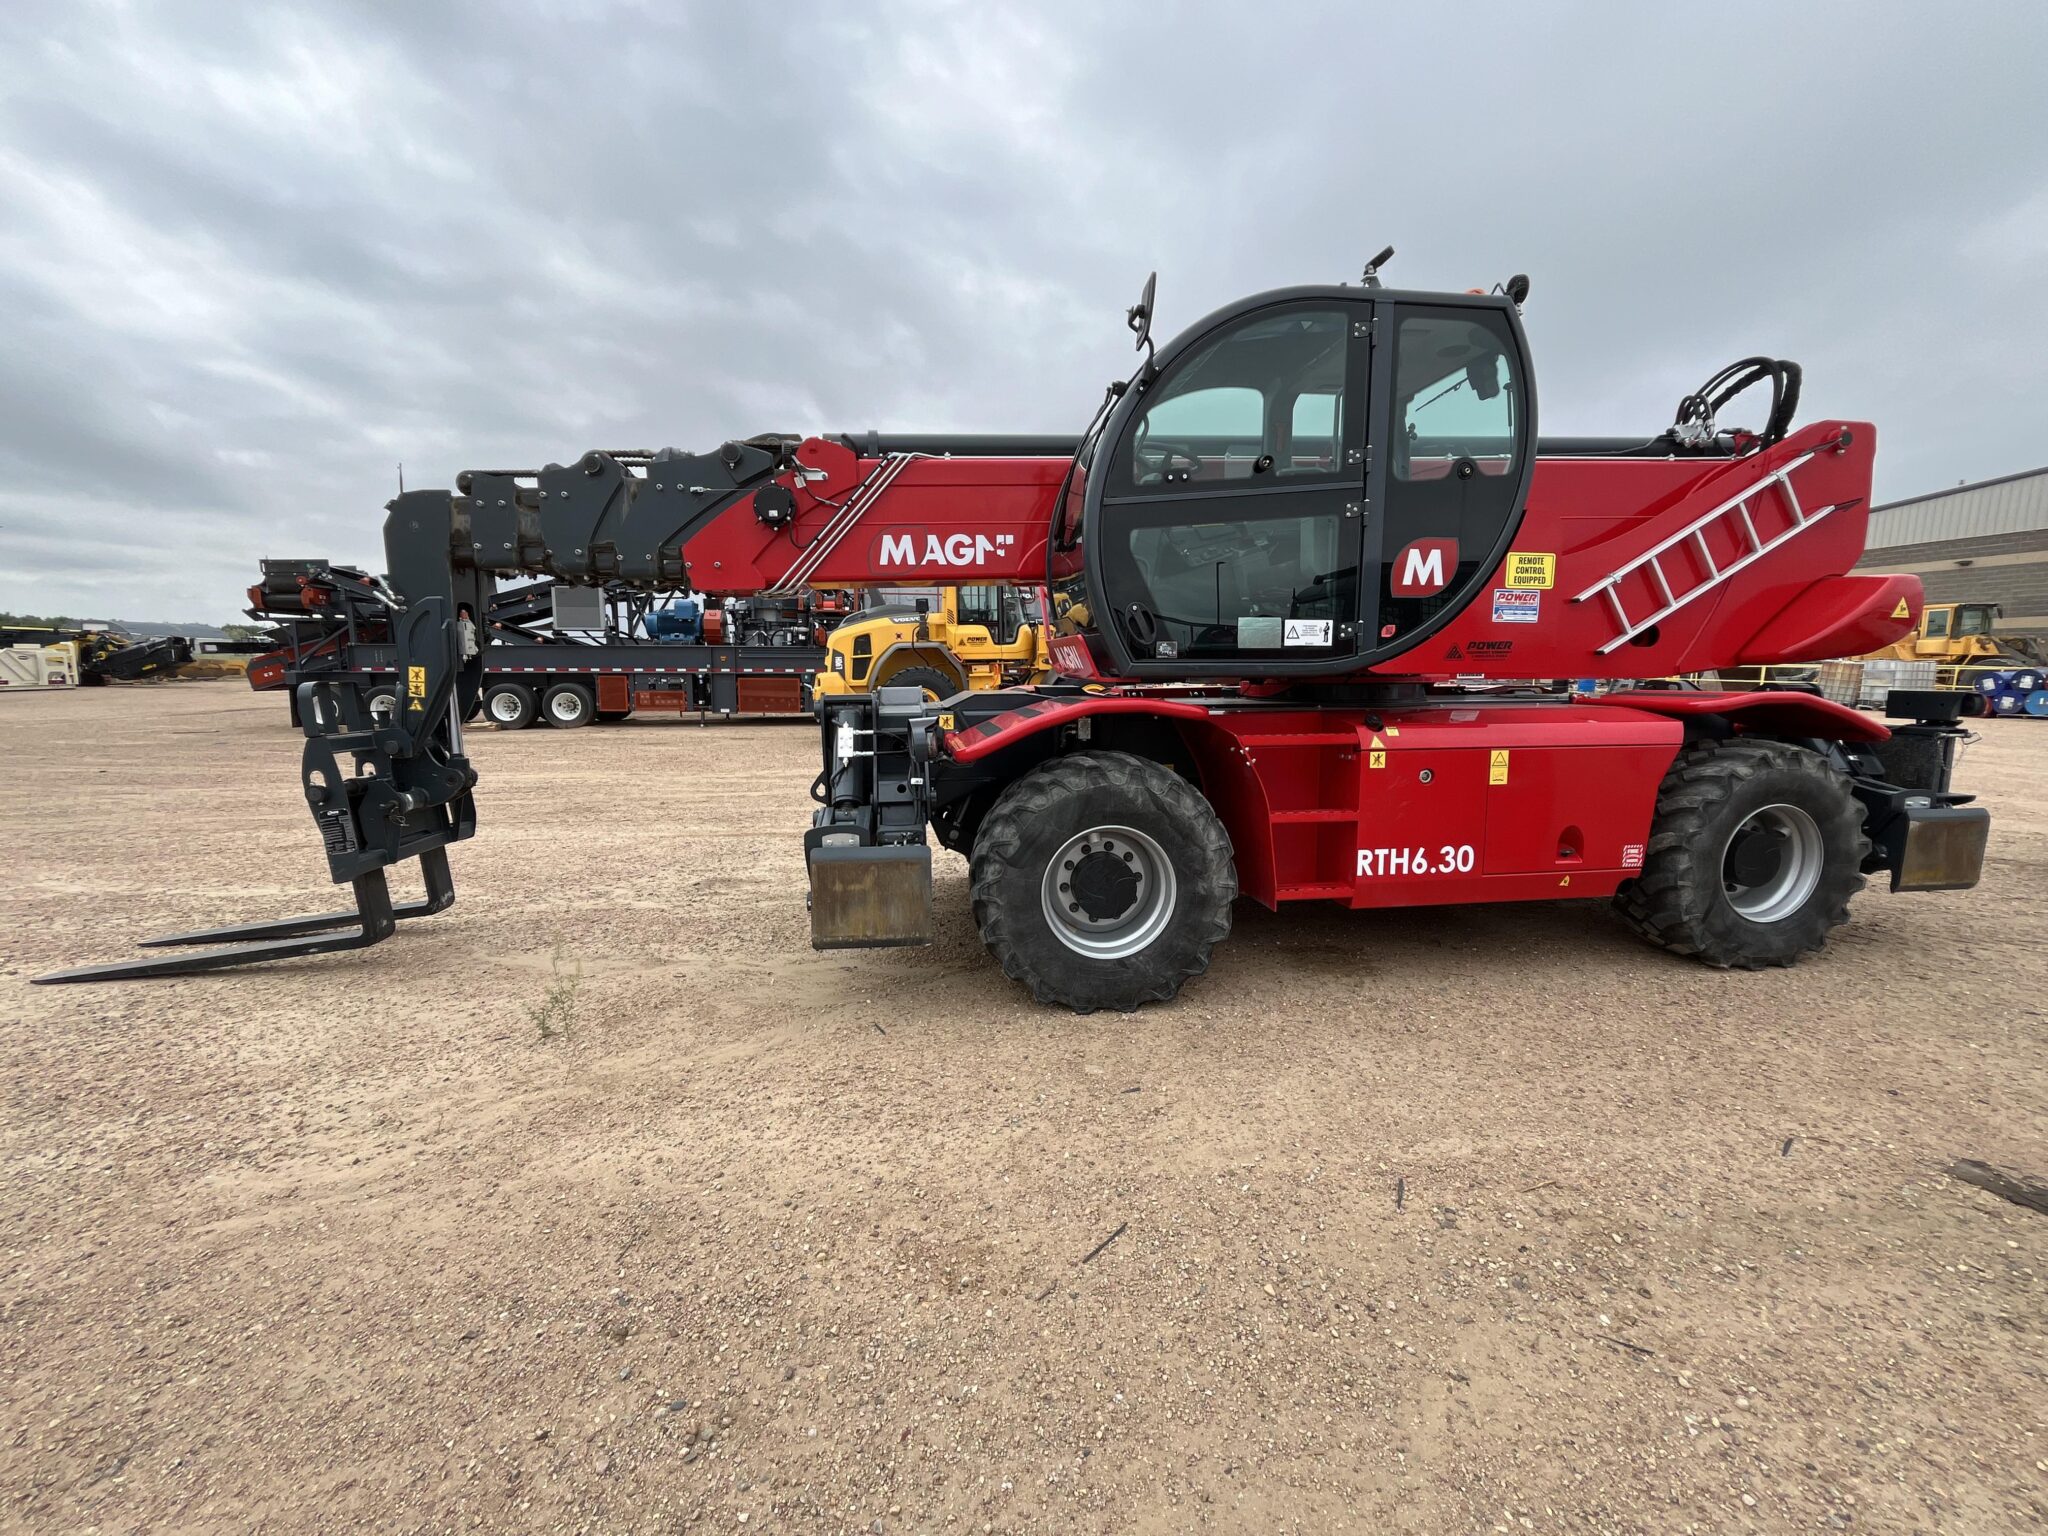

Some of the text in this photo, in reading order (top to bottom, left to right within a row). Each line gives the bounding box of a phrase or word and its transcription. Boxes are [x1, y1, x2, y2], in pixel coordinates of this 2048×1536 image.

[1518, 556, 1545, 565] REMOTE
[1402, 548, 1443, 586] M
[1515, 566, 1546, 575] CONTROL
[1513, 575, 1546, 585] EQUIPPED
[1497, 592, 1538, 602] POWER
[1466, 640, 1513, 650] POWER
[1356, 844, 1475, 876] RTH6.30
